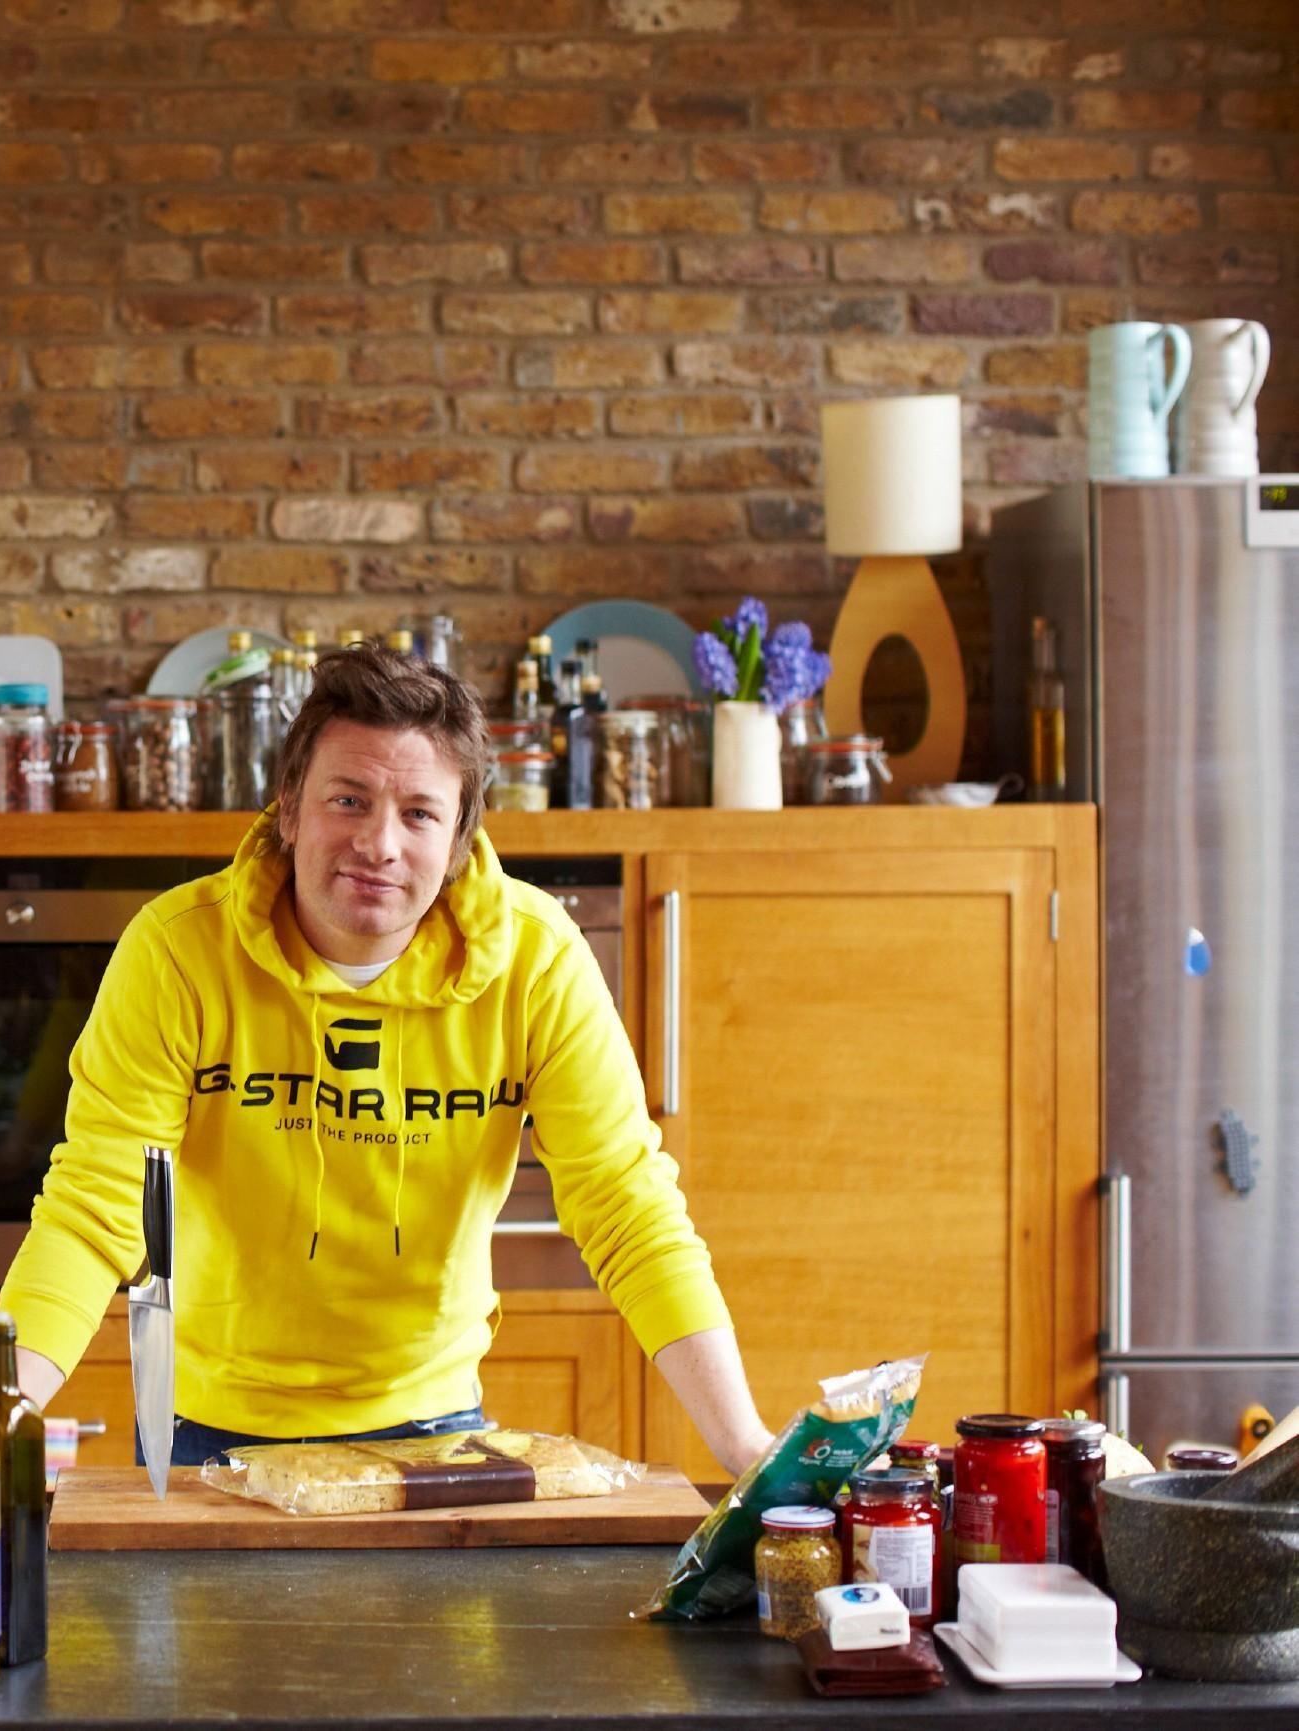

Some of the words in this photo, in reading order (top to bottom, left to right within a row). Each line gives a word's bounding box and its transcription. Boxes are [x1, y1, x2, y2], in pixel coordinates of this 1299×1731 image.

[404, 1077, 524, 1121] RAW
[275, 1117, 313, 1131] JUST
[320, 1122, 346, 1141] THE
